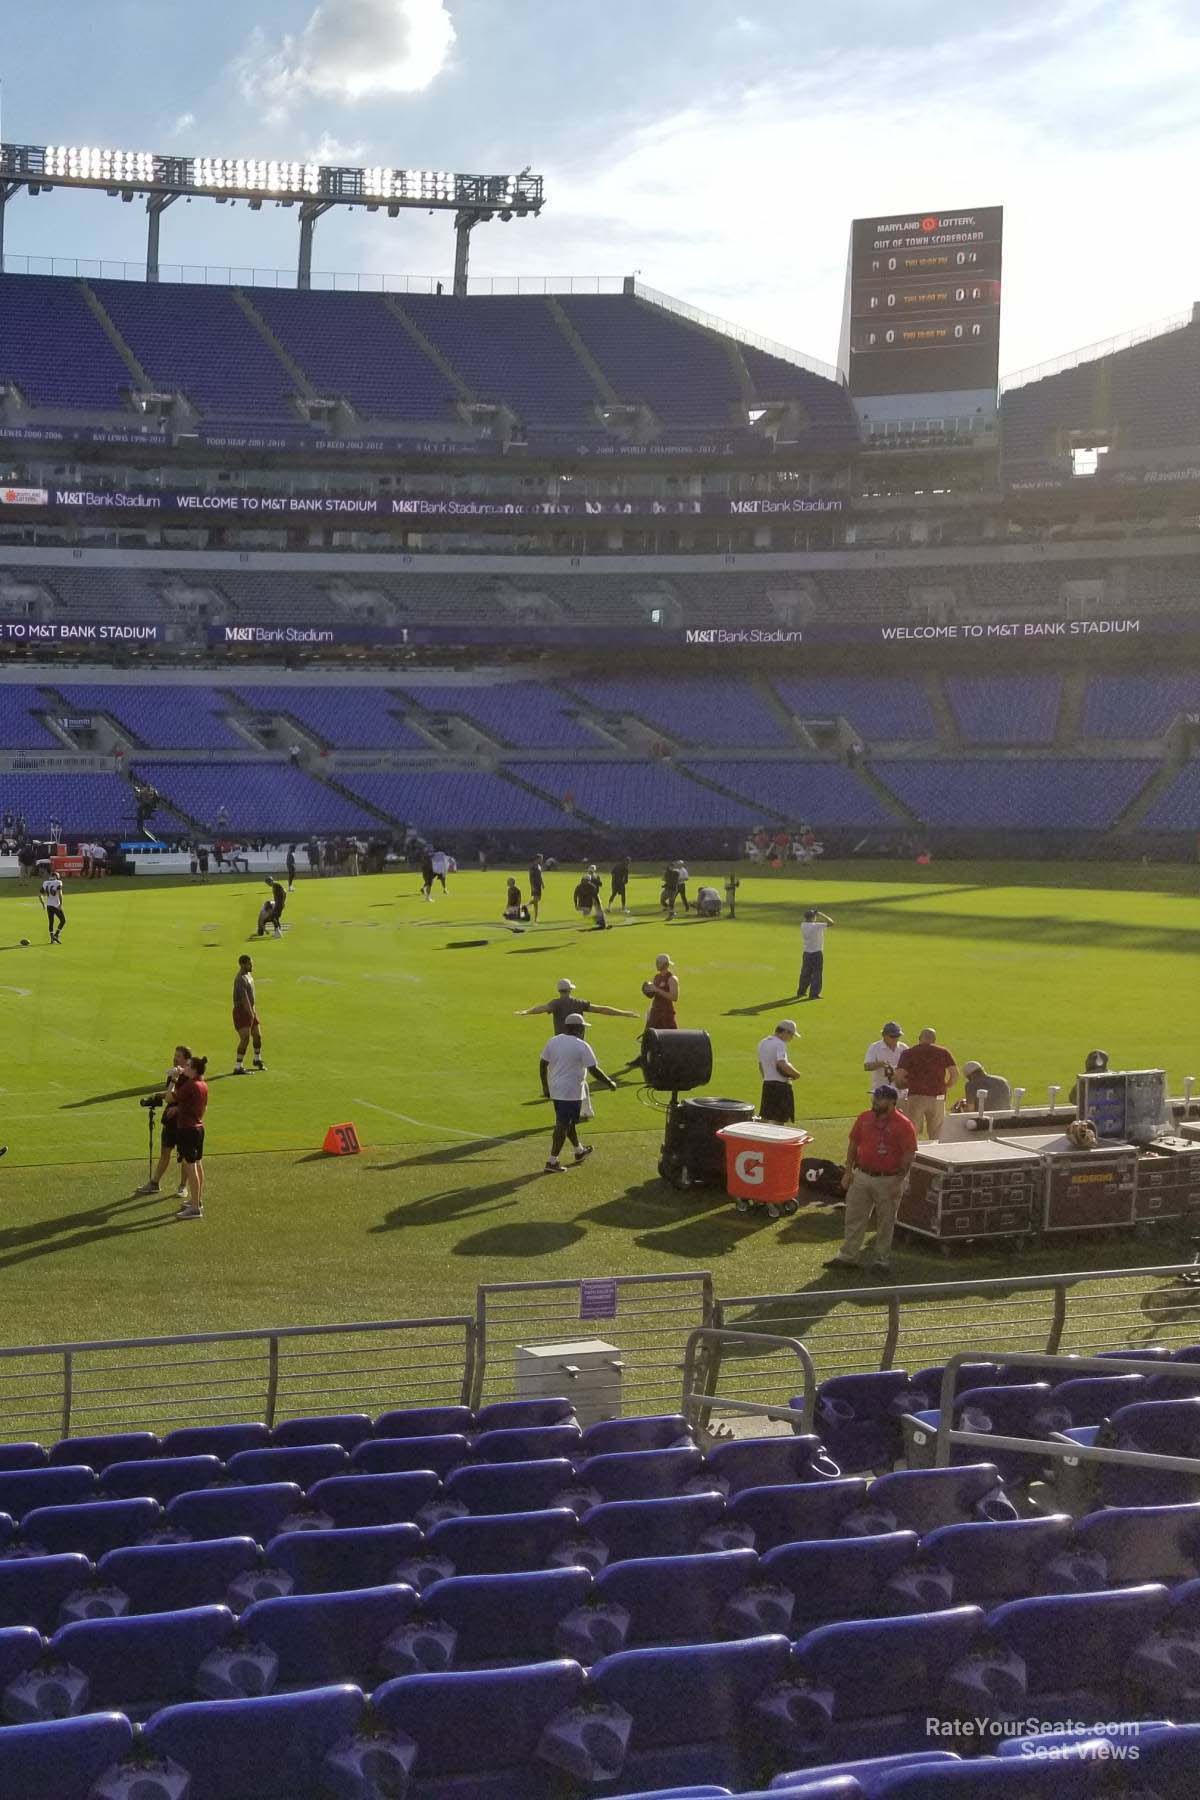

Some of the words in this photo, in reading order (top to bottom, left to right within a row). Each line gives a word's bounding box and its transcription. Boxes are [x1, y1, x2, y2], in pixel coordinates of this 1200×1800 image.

[877, 222, 920, 233] MARYLAND
[874, 241, 890, 249] OUT
[893, 240, 903, 248] OF
[906, 237, 929, 246] TOWN
[932, 232, 984, 244] SCOREBOARD
[56, 491, 85, 505] M&T
[86, 493, 115, 506] Bank
[115, 494, 161, 507] Stadium
[176, 496, 238, 509] WELCOME
[241, 497, 259, 510] TO
[261, 498, 288, 510] M&T
[290, 499, 323, 511] BANK
[325, 500, 377, 512] STADIUM
[392, 500, 420, 513] M&T
[420, 501, 447, 513] Bank
[730, 501, 761, 513] M&T
[762, 500, 791, 512] Bank
[792, 499, 841, 512] Stadium
[6, 624, 25, 636] TO
[29, 625, 57, 637] M&T
[61, 626, 96, 638] BANK
[99, 626, 157, 639] STADIUM
[224, 627, 255, 641] M&T
[256, 628, 284, 641] Bank
[286, 628, 333, 642] Stadium
[686, 629, 718, 643] M&T
[718, 629, 750, 643] Bank
[750, 629, 802, 643] Stadium
[881, 626, 957, 640] WELCOME
[962, 625, 983, 637] TO
[987, 624, 1020, 637] M&T
[1024, 623, 1066, 635] BANK
[1070, 620, 1140, 634] STADIUM
[335, 1127, 360, 1153] 30
[735, 1151, 764, 1184] G
